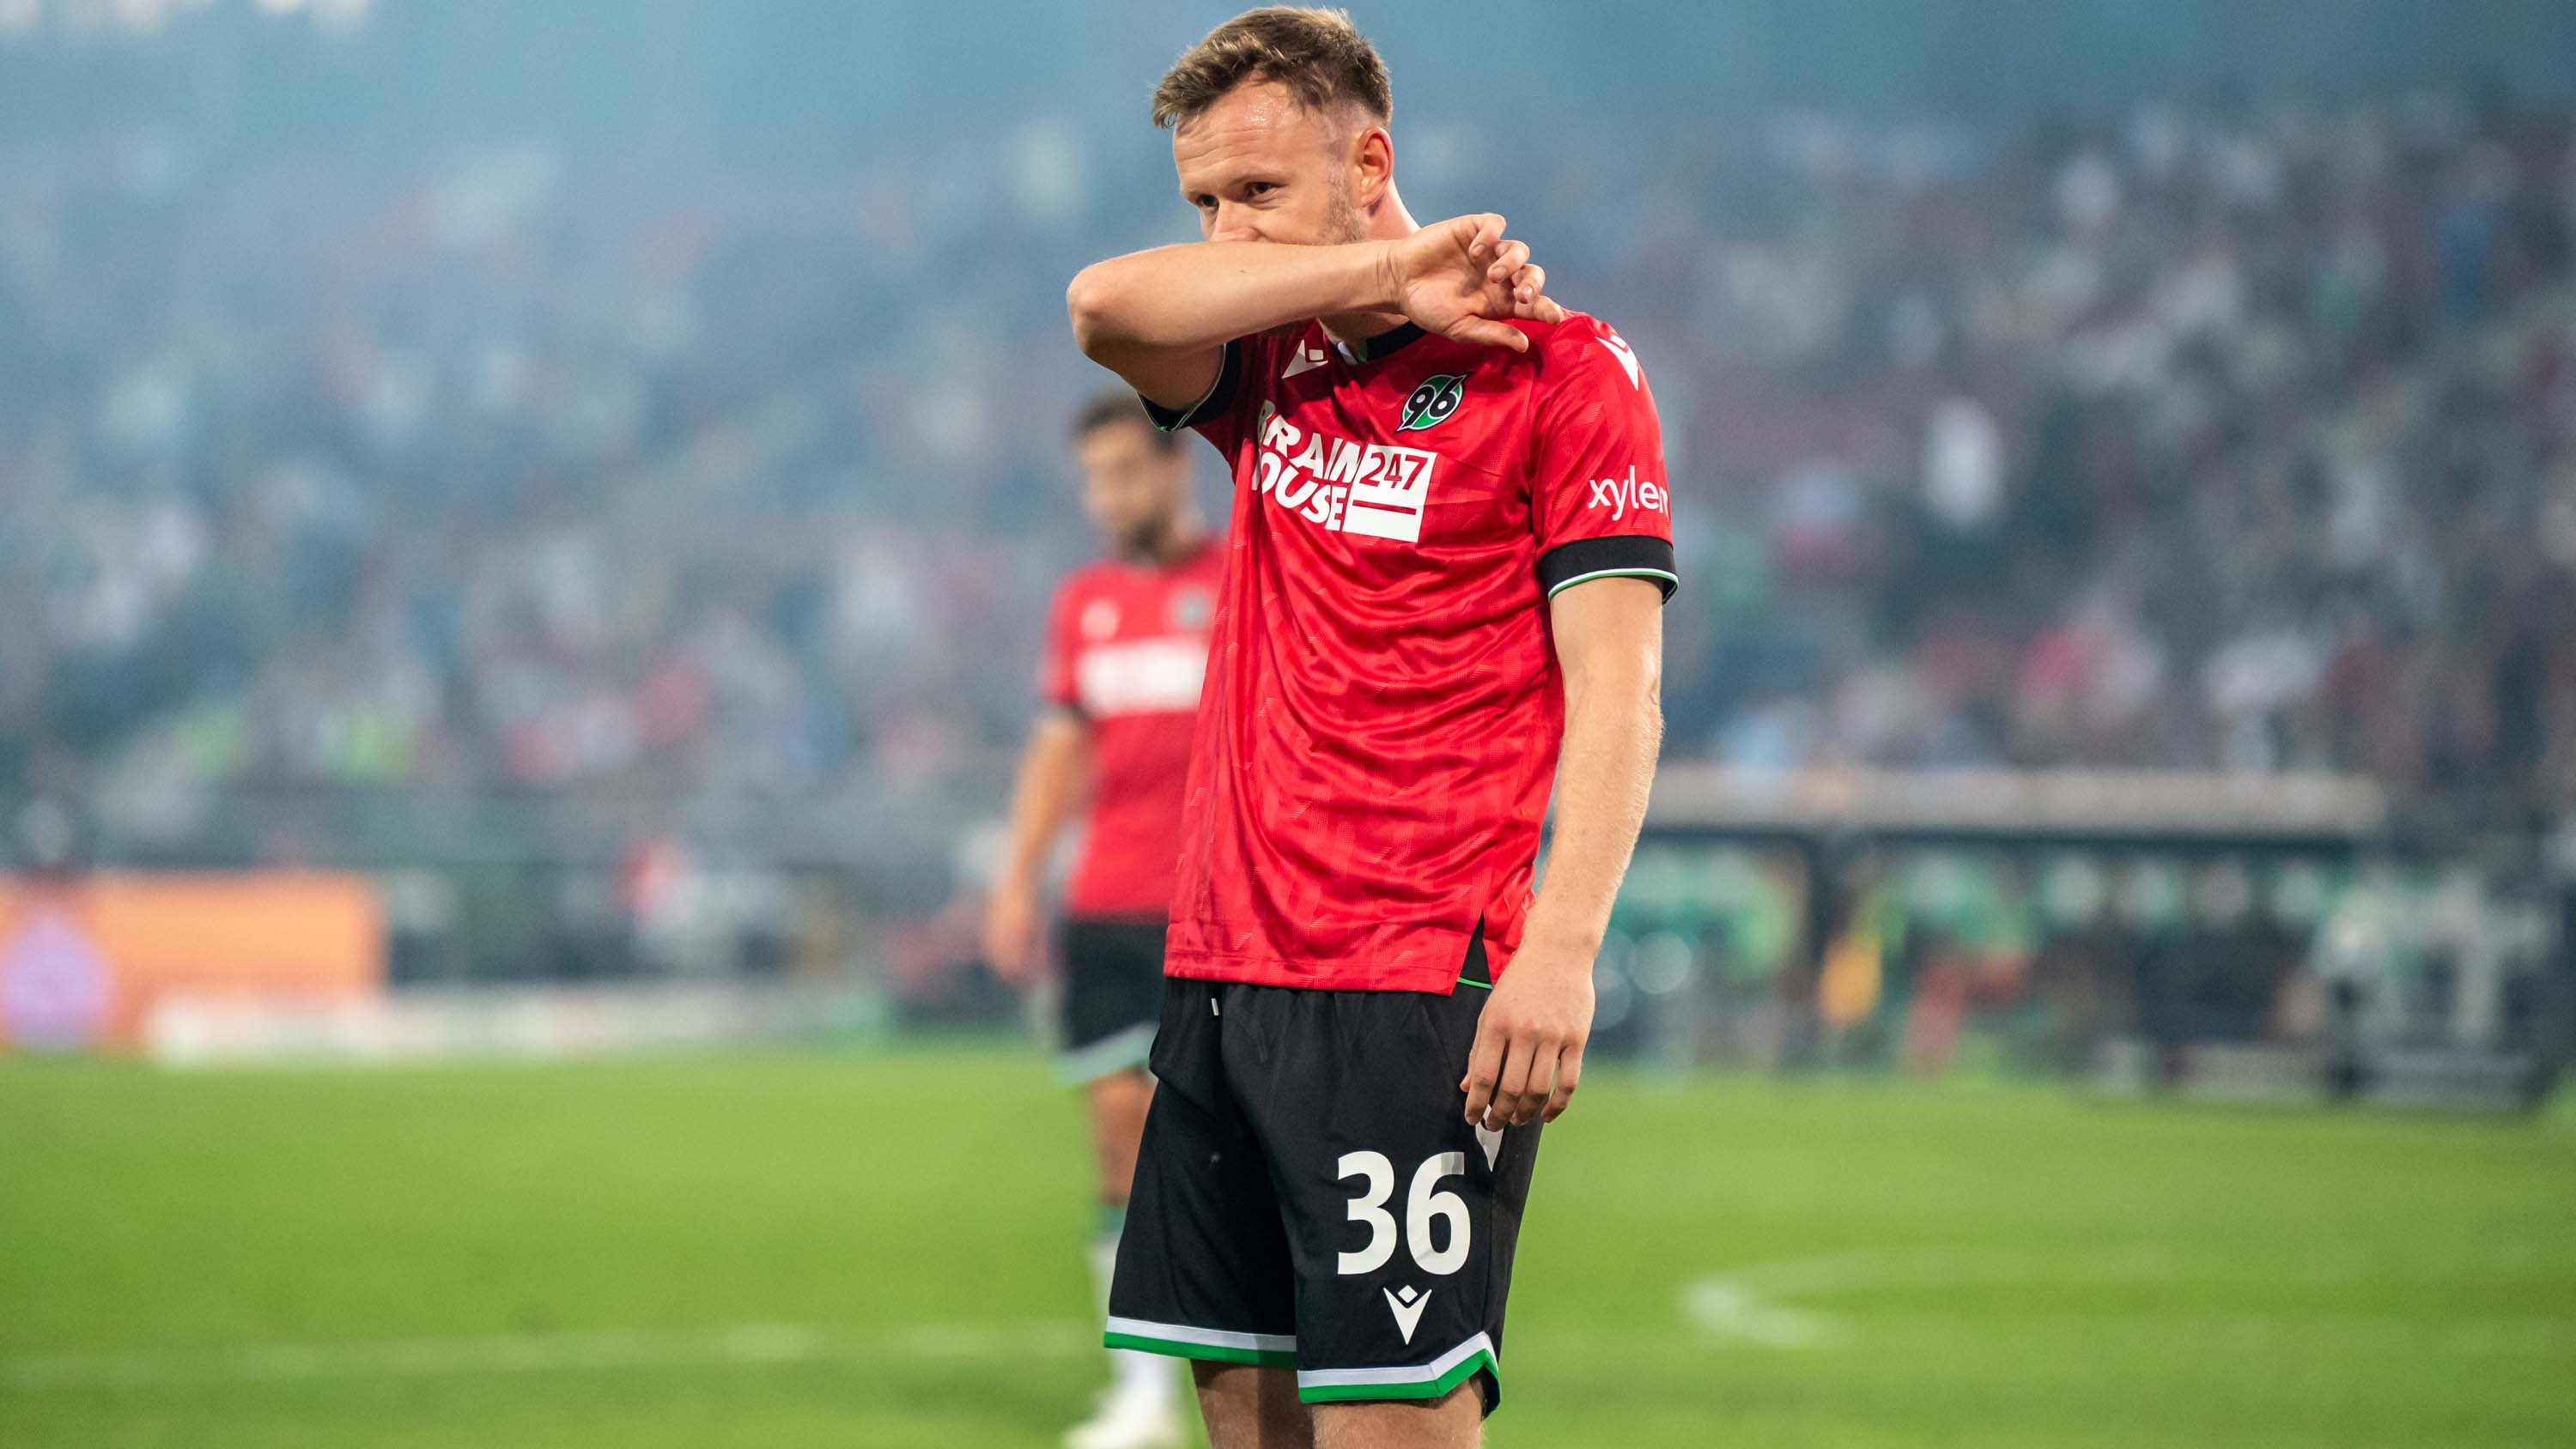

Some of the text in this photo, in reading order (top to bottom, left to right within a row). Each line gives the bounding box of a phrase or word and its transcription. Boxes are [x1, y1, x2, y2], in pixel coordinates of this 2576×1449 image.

[1397, 373, 1468, 433] 96
[1359, 452, 1429, 491] 247
[1337, 1150, 1471, 1276] 36
